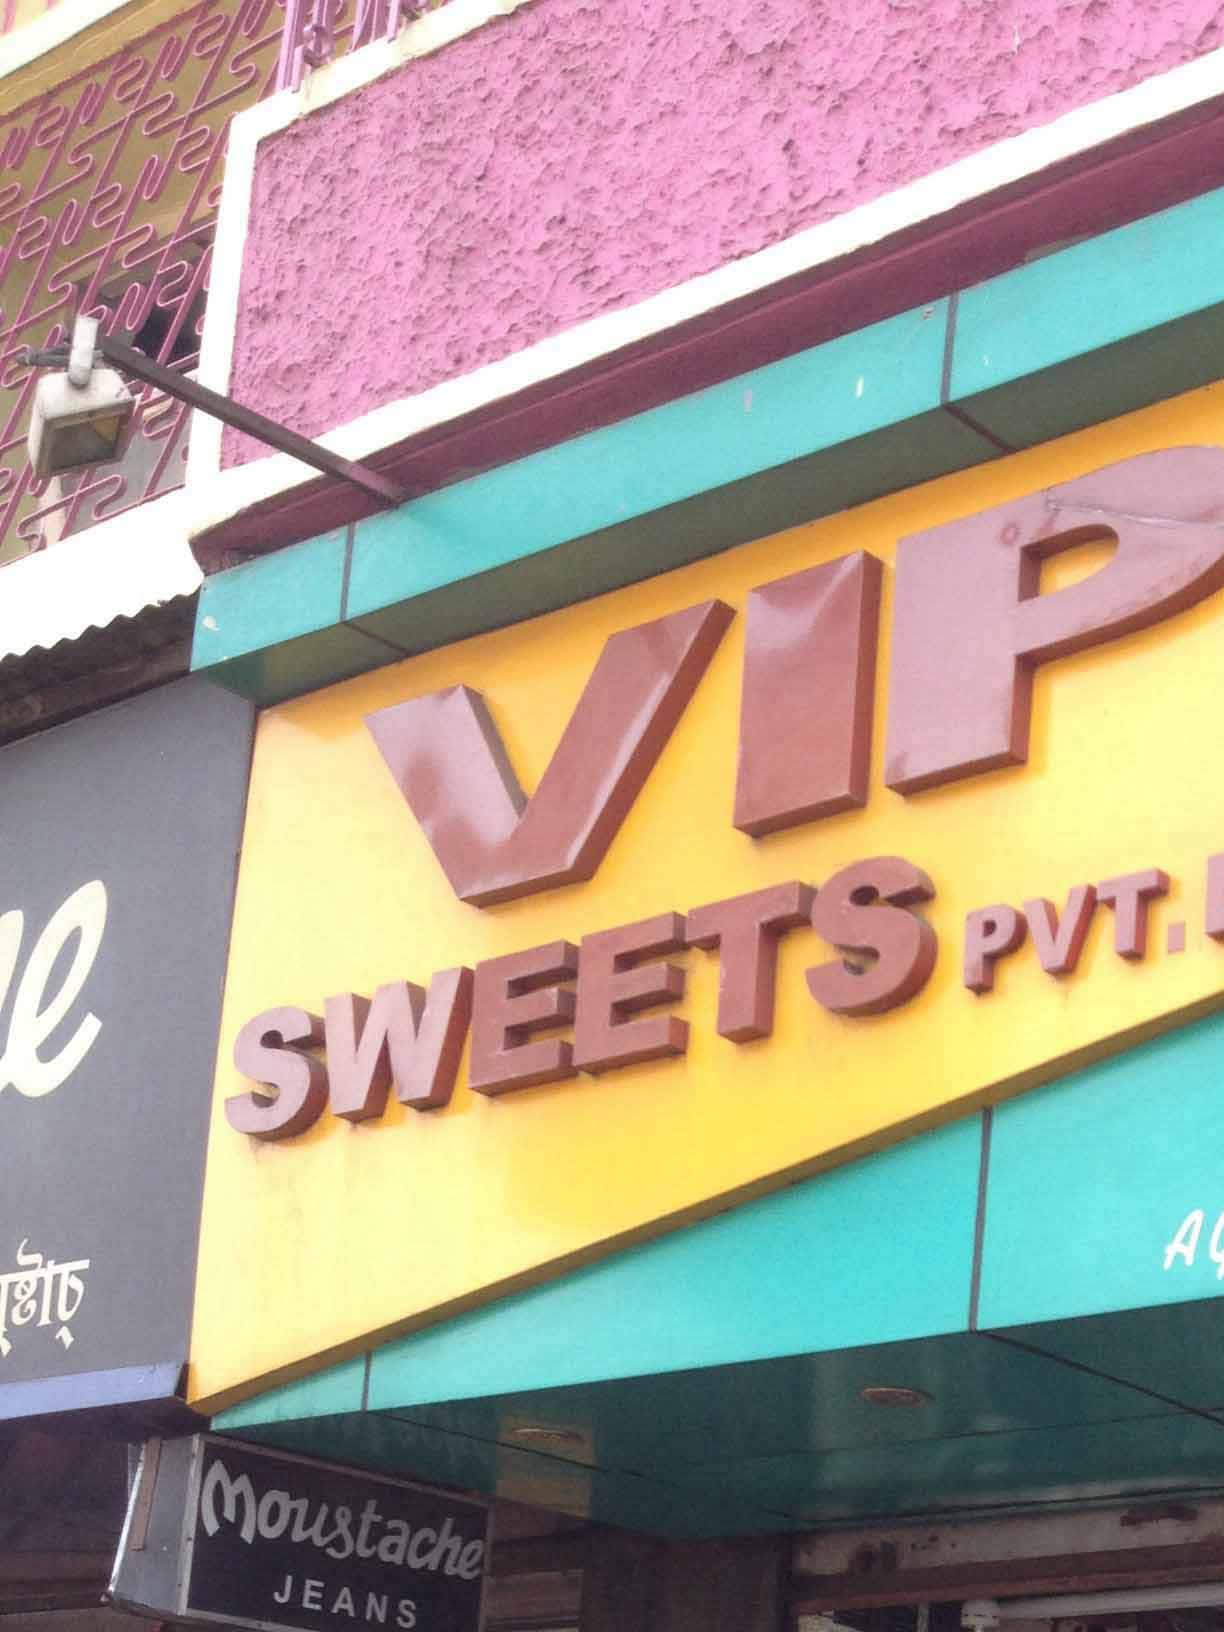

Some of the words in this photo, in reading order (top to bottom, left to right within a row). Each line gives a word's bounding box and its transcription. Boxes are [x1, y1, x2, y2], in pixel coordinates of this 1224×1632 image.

[224, 855, 938, 1142] SWEETS
[1163, 1209, 1206, 1270] A
[202, 1459, 486, 1580] Moustache
[273, 1574, 418, 1629] JEANS
